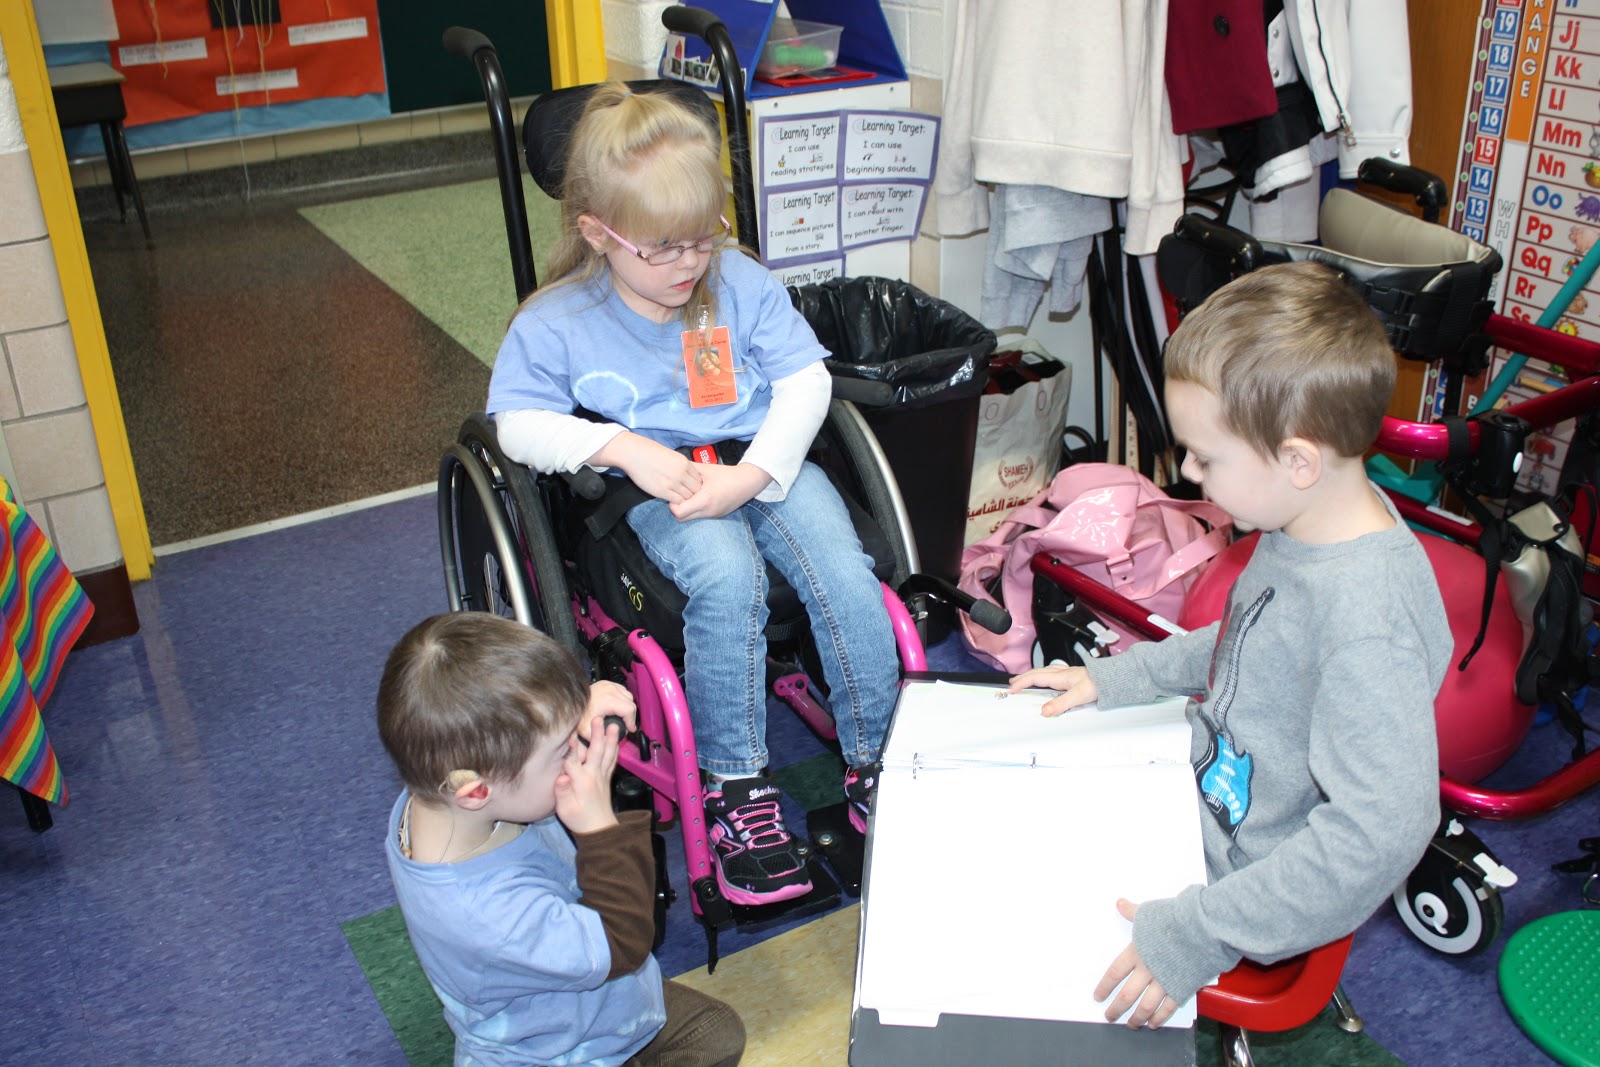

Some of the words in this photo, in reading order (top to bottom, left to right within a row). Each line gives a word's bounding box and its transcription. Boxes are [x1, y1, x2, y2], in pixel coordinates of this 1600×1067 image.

[1499, 12, 1515, 32] 19
[1559, 20, 1580, 51] Jj
[1494, 45, 1509, 64] 18
[1554, 54, 1583, 80] Kk
[1489, 77, 1505, 96] 17
[1548, 87, 1566, 111] Ll
[1485, 108, 1499, 127] 16
[780, 126, 809, 141] Learning
[812, 124, 836, 140] Target:
[862, 119, 895, 135] Learning
[898, 121, 926, 136] Target:
[1542, 120, 1582, 148] Mm
[1479, 139, 1494, 157] 15
[771, 168, 797, 176] reading
[799, 164, 834, 173] strategies
[846, 165, 885, 175] beginning
[1537, 153, 1566, 178] Nn
[1475, 168, 1490, 187] 14
[783, 195, 811, 209] Learning
[855, 187, 885, 202] Learning
[888, 187, 914, 201] Target:
[1532, 185, 1562, 210] Oo
[868, 207, 885, 215] read
[1470, 198, 1485, 217] 13
[786, 227, 811, 235] sequence
[812, 223, 834, 232] pictures
[854, 228, 879, 238] pointer
[1525, 215, 1553, 243] Pp
[1521, 246, 1552, 277] Qq
[783, 271, 811, 286] Learning
[1514, 276, 1537, 299] Rr
